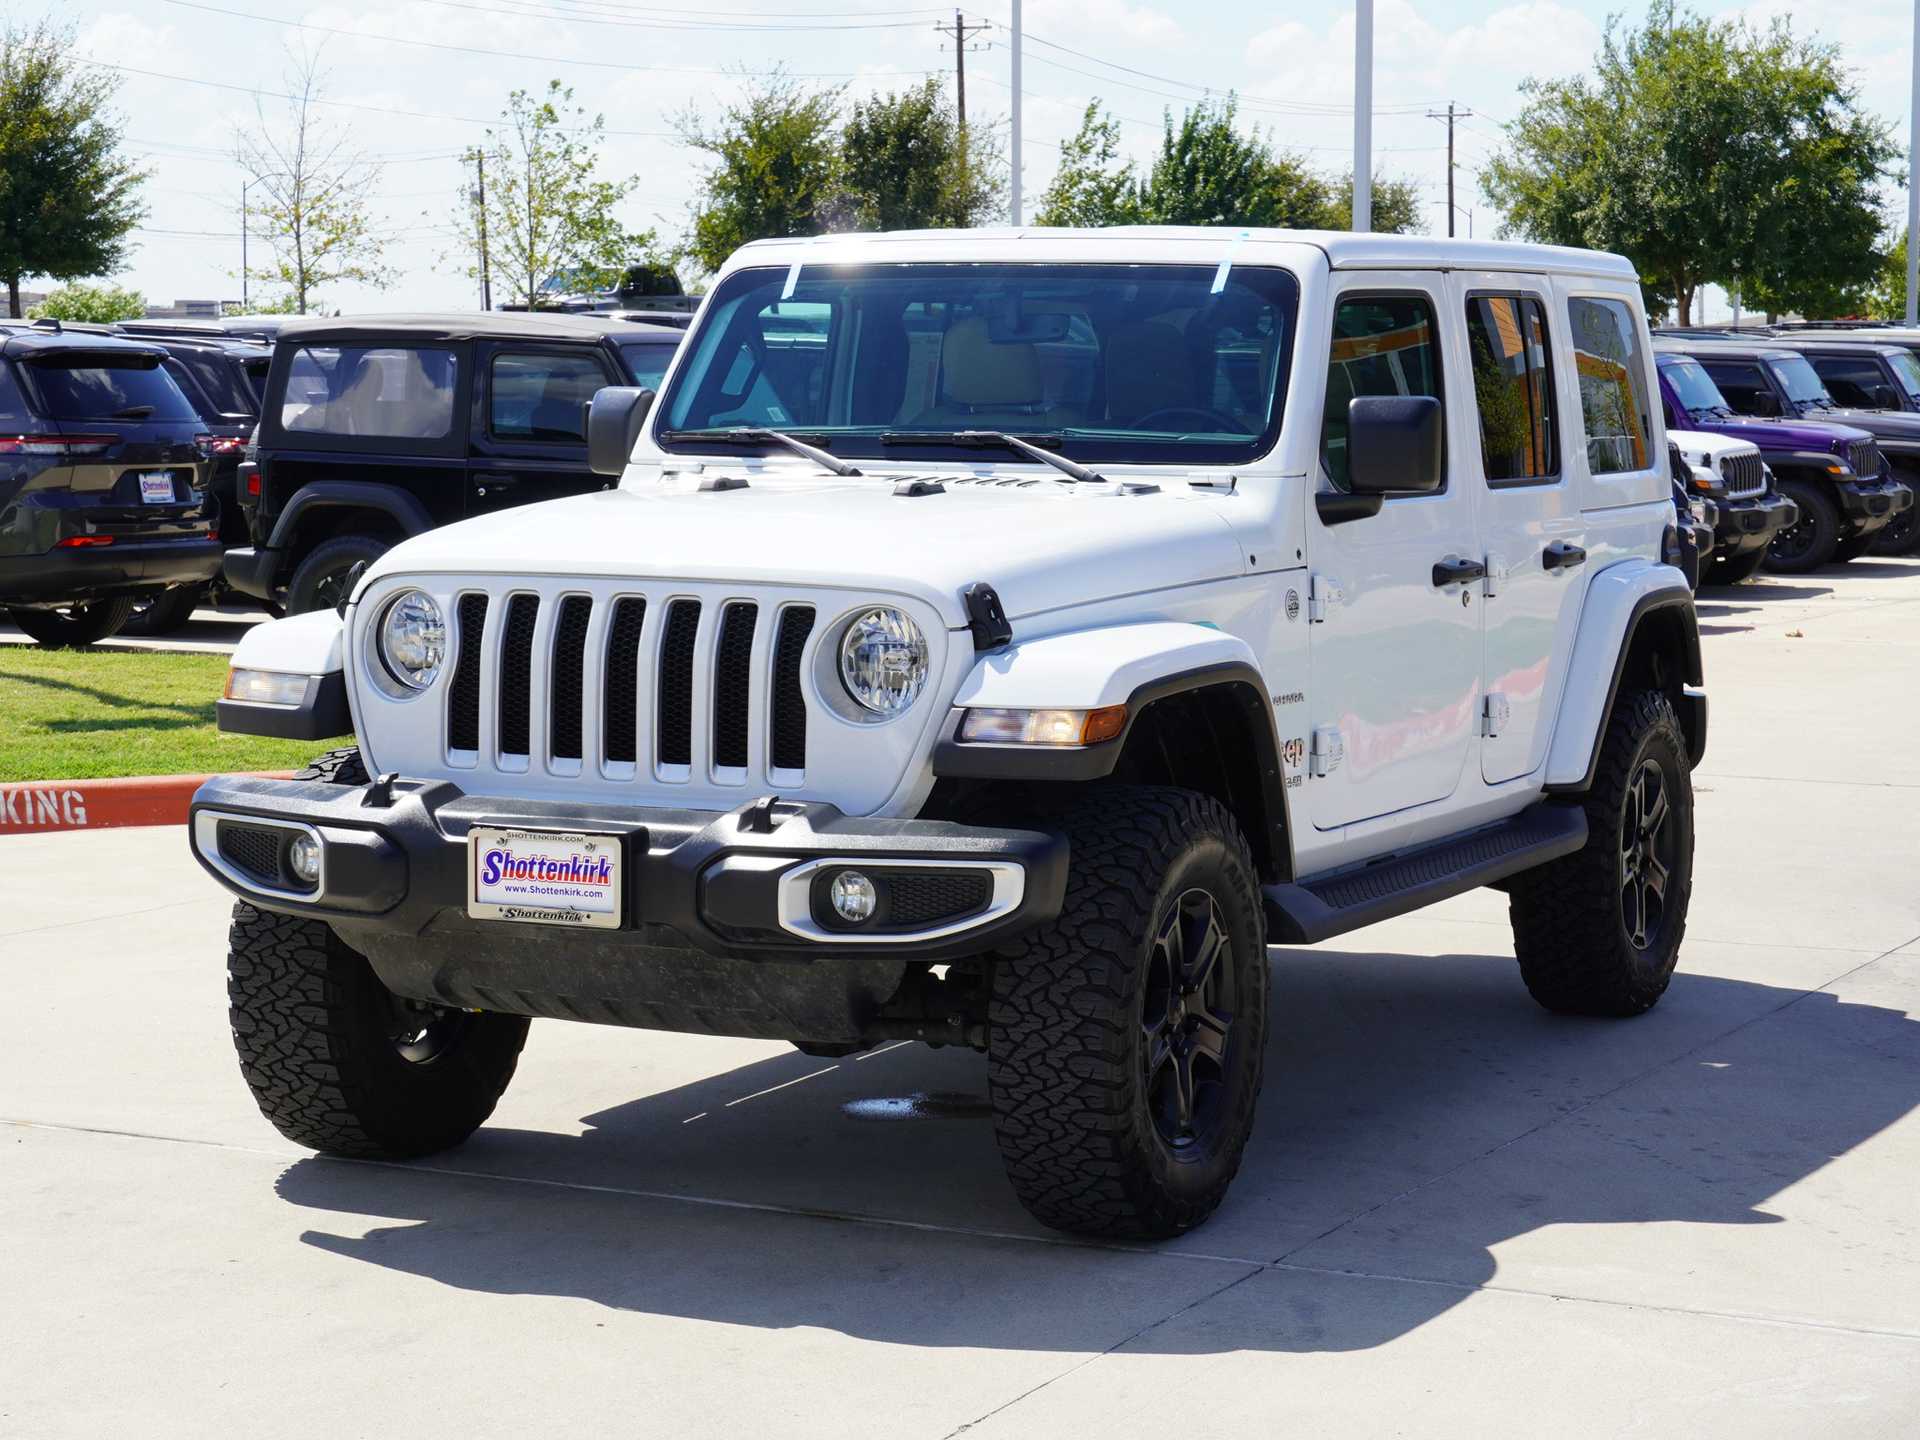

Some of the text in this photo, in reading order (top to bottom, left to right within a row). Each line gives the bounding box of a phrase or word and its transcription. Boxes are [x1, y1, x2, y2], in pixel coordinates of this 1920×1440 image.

[506, 832, 584, 843] SHOTTENKIRK.COM
[482, 849, 614, 886] Shottenkirk
[504, 885, 603, 898] www.Shottenkirk.com
[503, 906, 583, 922] Shottenkirk
